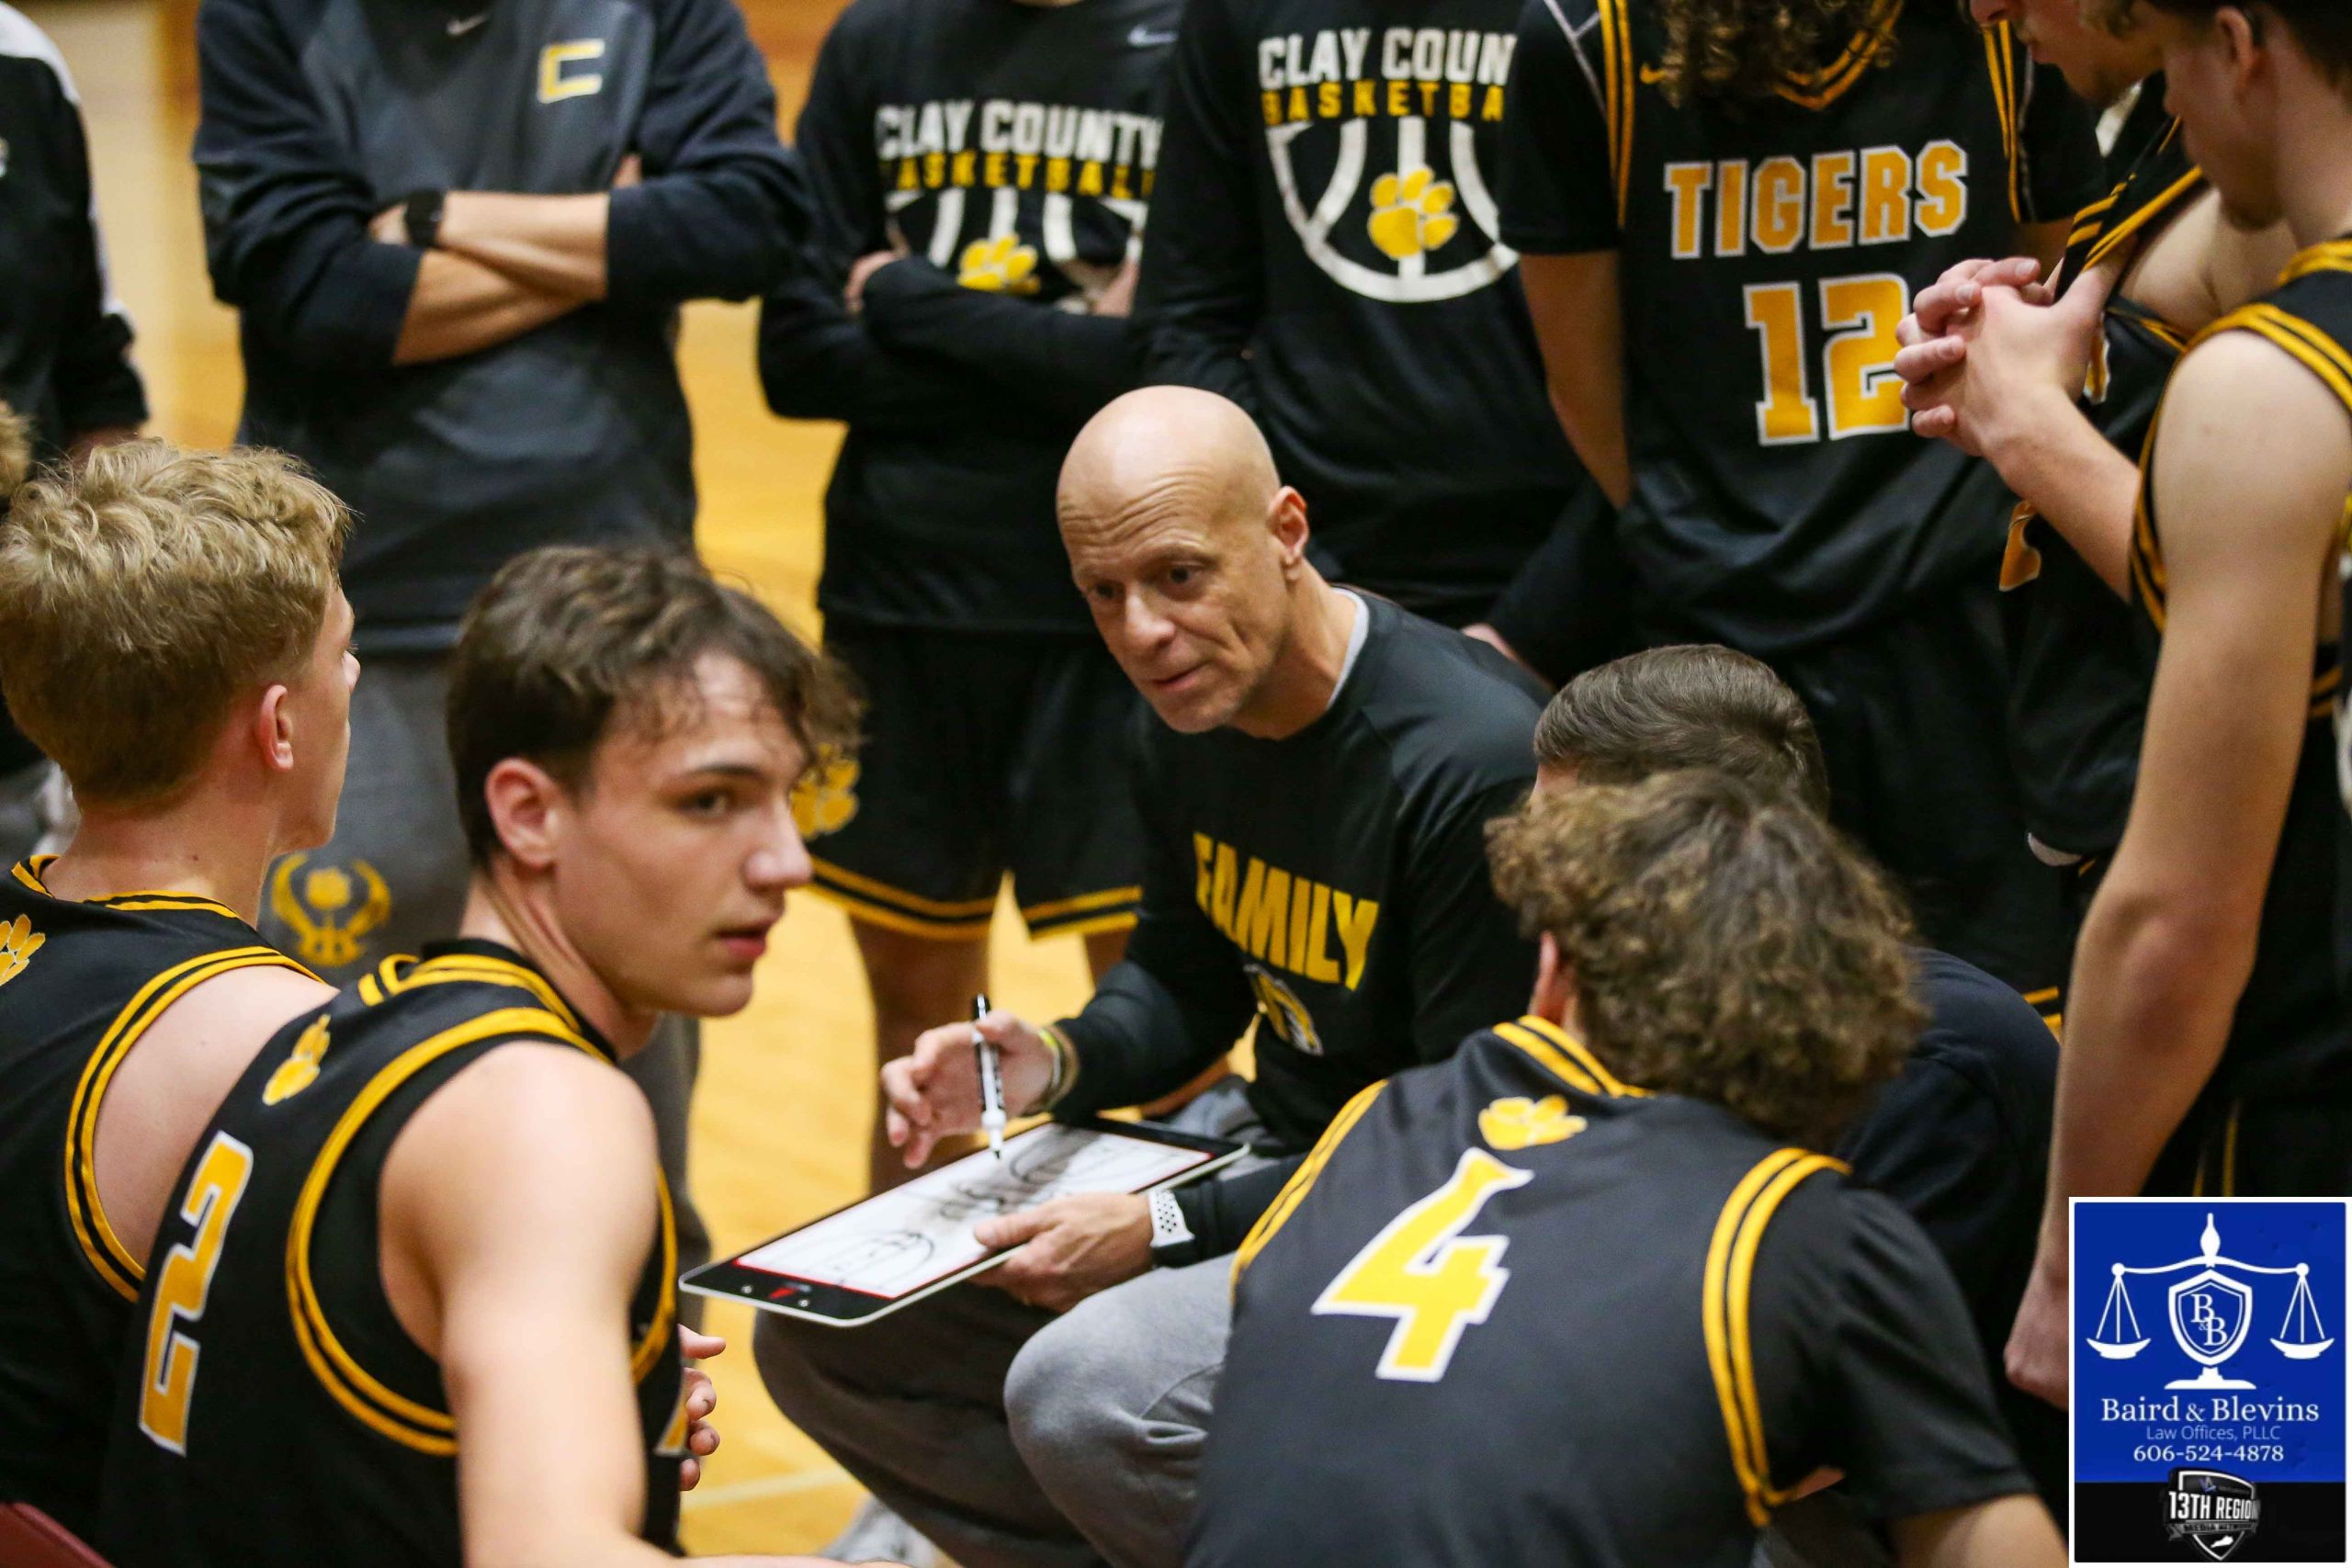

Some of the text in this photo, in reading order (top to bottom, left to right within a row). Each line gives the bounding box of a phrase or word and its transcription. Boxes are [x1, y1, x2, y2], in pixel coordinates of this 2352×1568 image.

[537, 38, 605, 104] C
[1259, 28, 1372, 90] CLAY
[875, 98, 1163, 169] CLAY COUNTY
[879, 150, 1156, 200] ASKETBAL
[1664, 139, 1969, 260] TIGERS
[1743, 273, 1910, 446] 12
[1193, 830, 1380, 992] FAMILY
[139, 1130, 254, 1458] 2
[1310, 1146, 1535, 1382] 4
